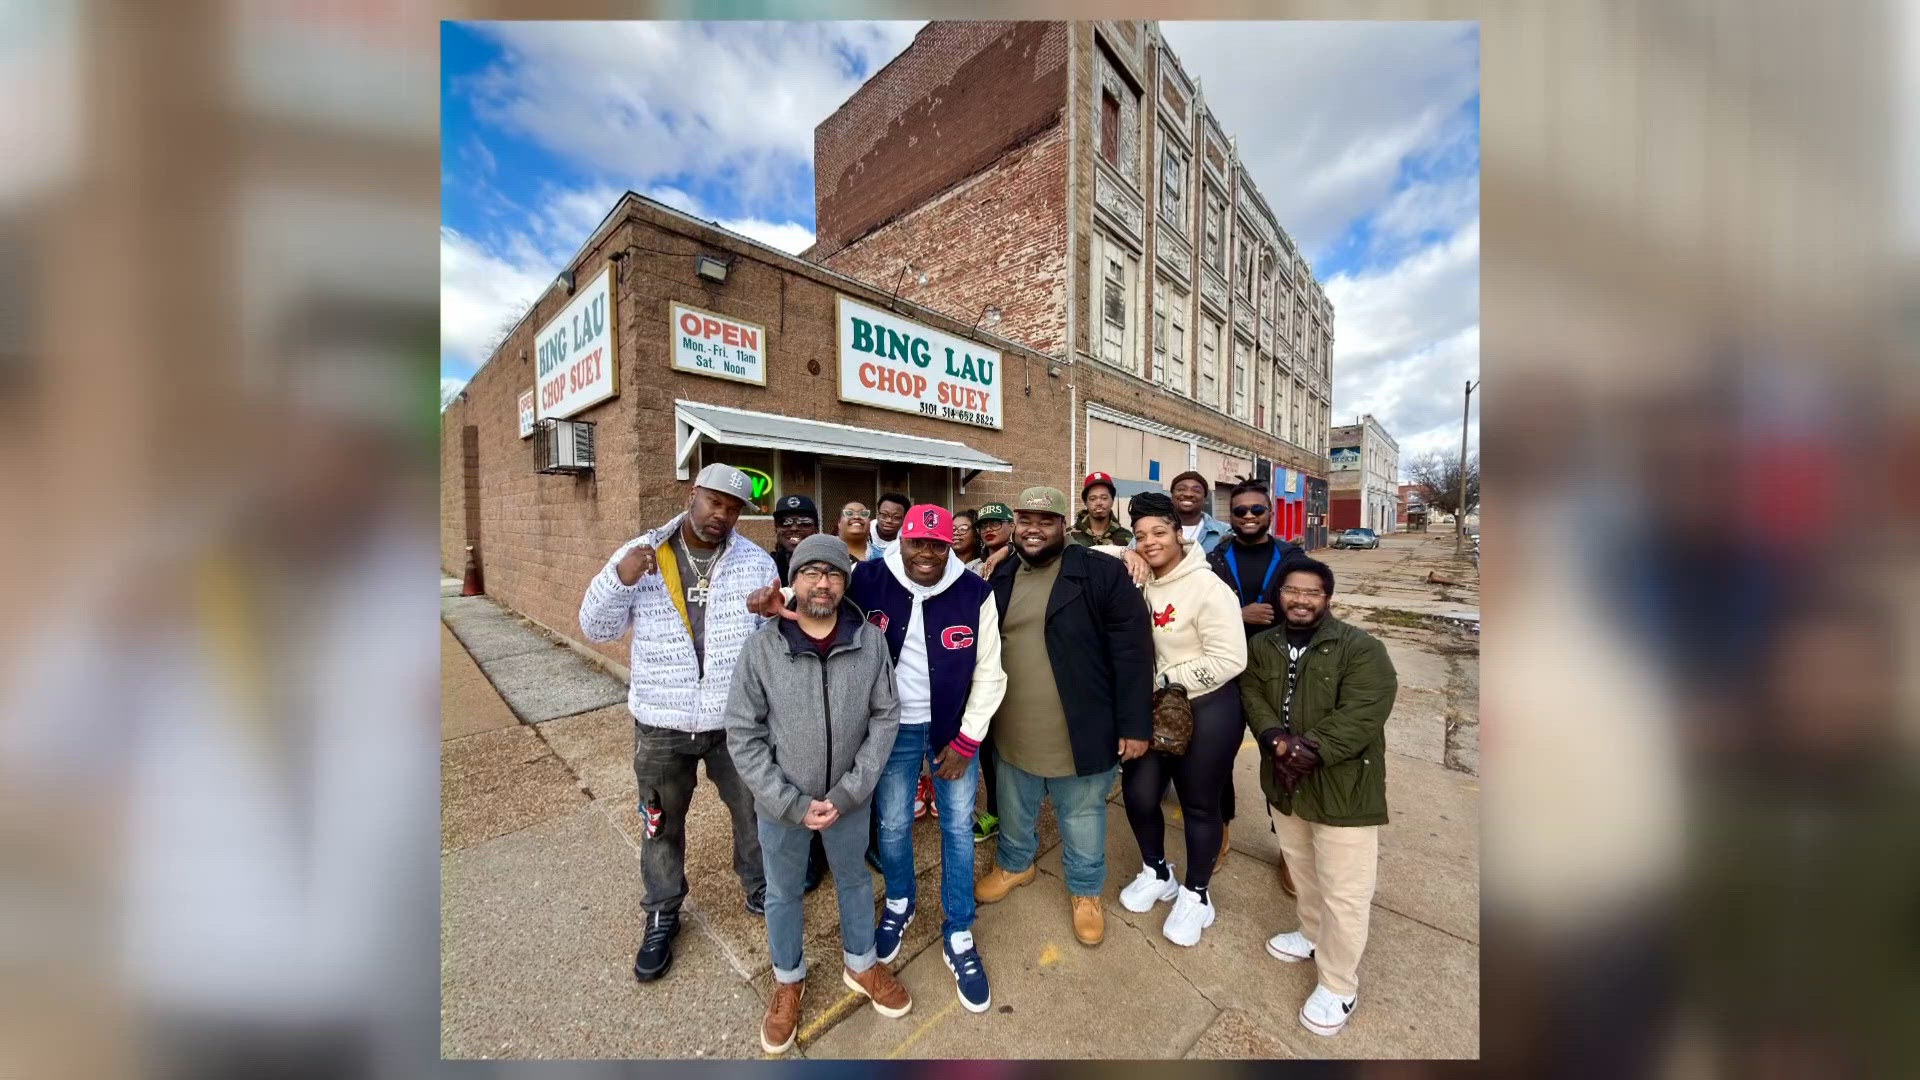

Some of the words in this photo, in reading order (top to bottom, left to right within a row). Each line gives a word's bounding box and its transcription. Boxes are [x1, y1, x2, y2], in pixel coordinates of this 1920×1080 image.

[539, 327, 567, 378] BING
[572, 292, 604, 352] LAU
[680, 313, 757, 351] OPEN
[851, 317, 931, 368] BING
[945, 348, 993, 385] LAU
[696, 355, 715, 369] Sat.
[724, 361, 746, 375] Noon
[737, 350, 756, 364] 11am
[542, 373, 565, 411] CHOP
[570, 347, 602, 394] SUEY
[859, 363, 927, 398] CHOP
[937, 381, 990, 412] SUEY
[919, 402, 937, 415] 3101
[976, 413, 994, 426] 8822
[714, 609, 745, 620] ARMANI
